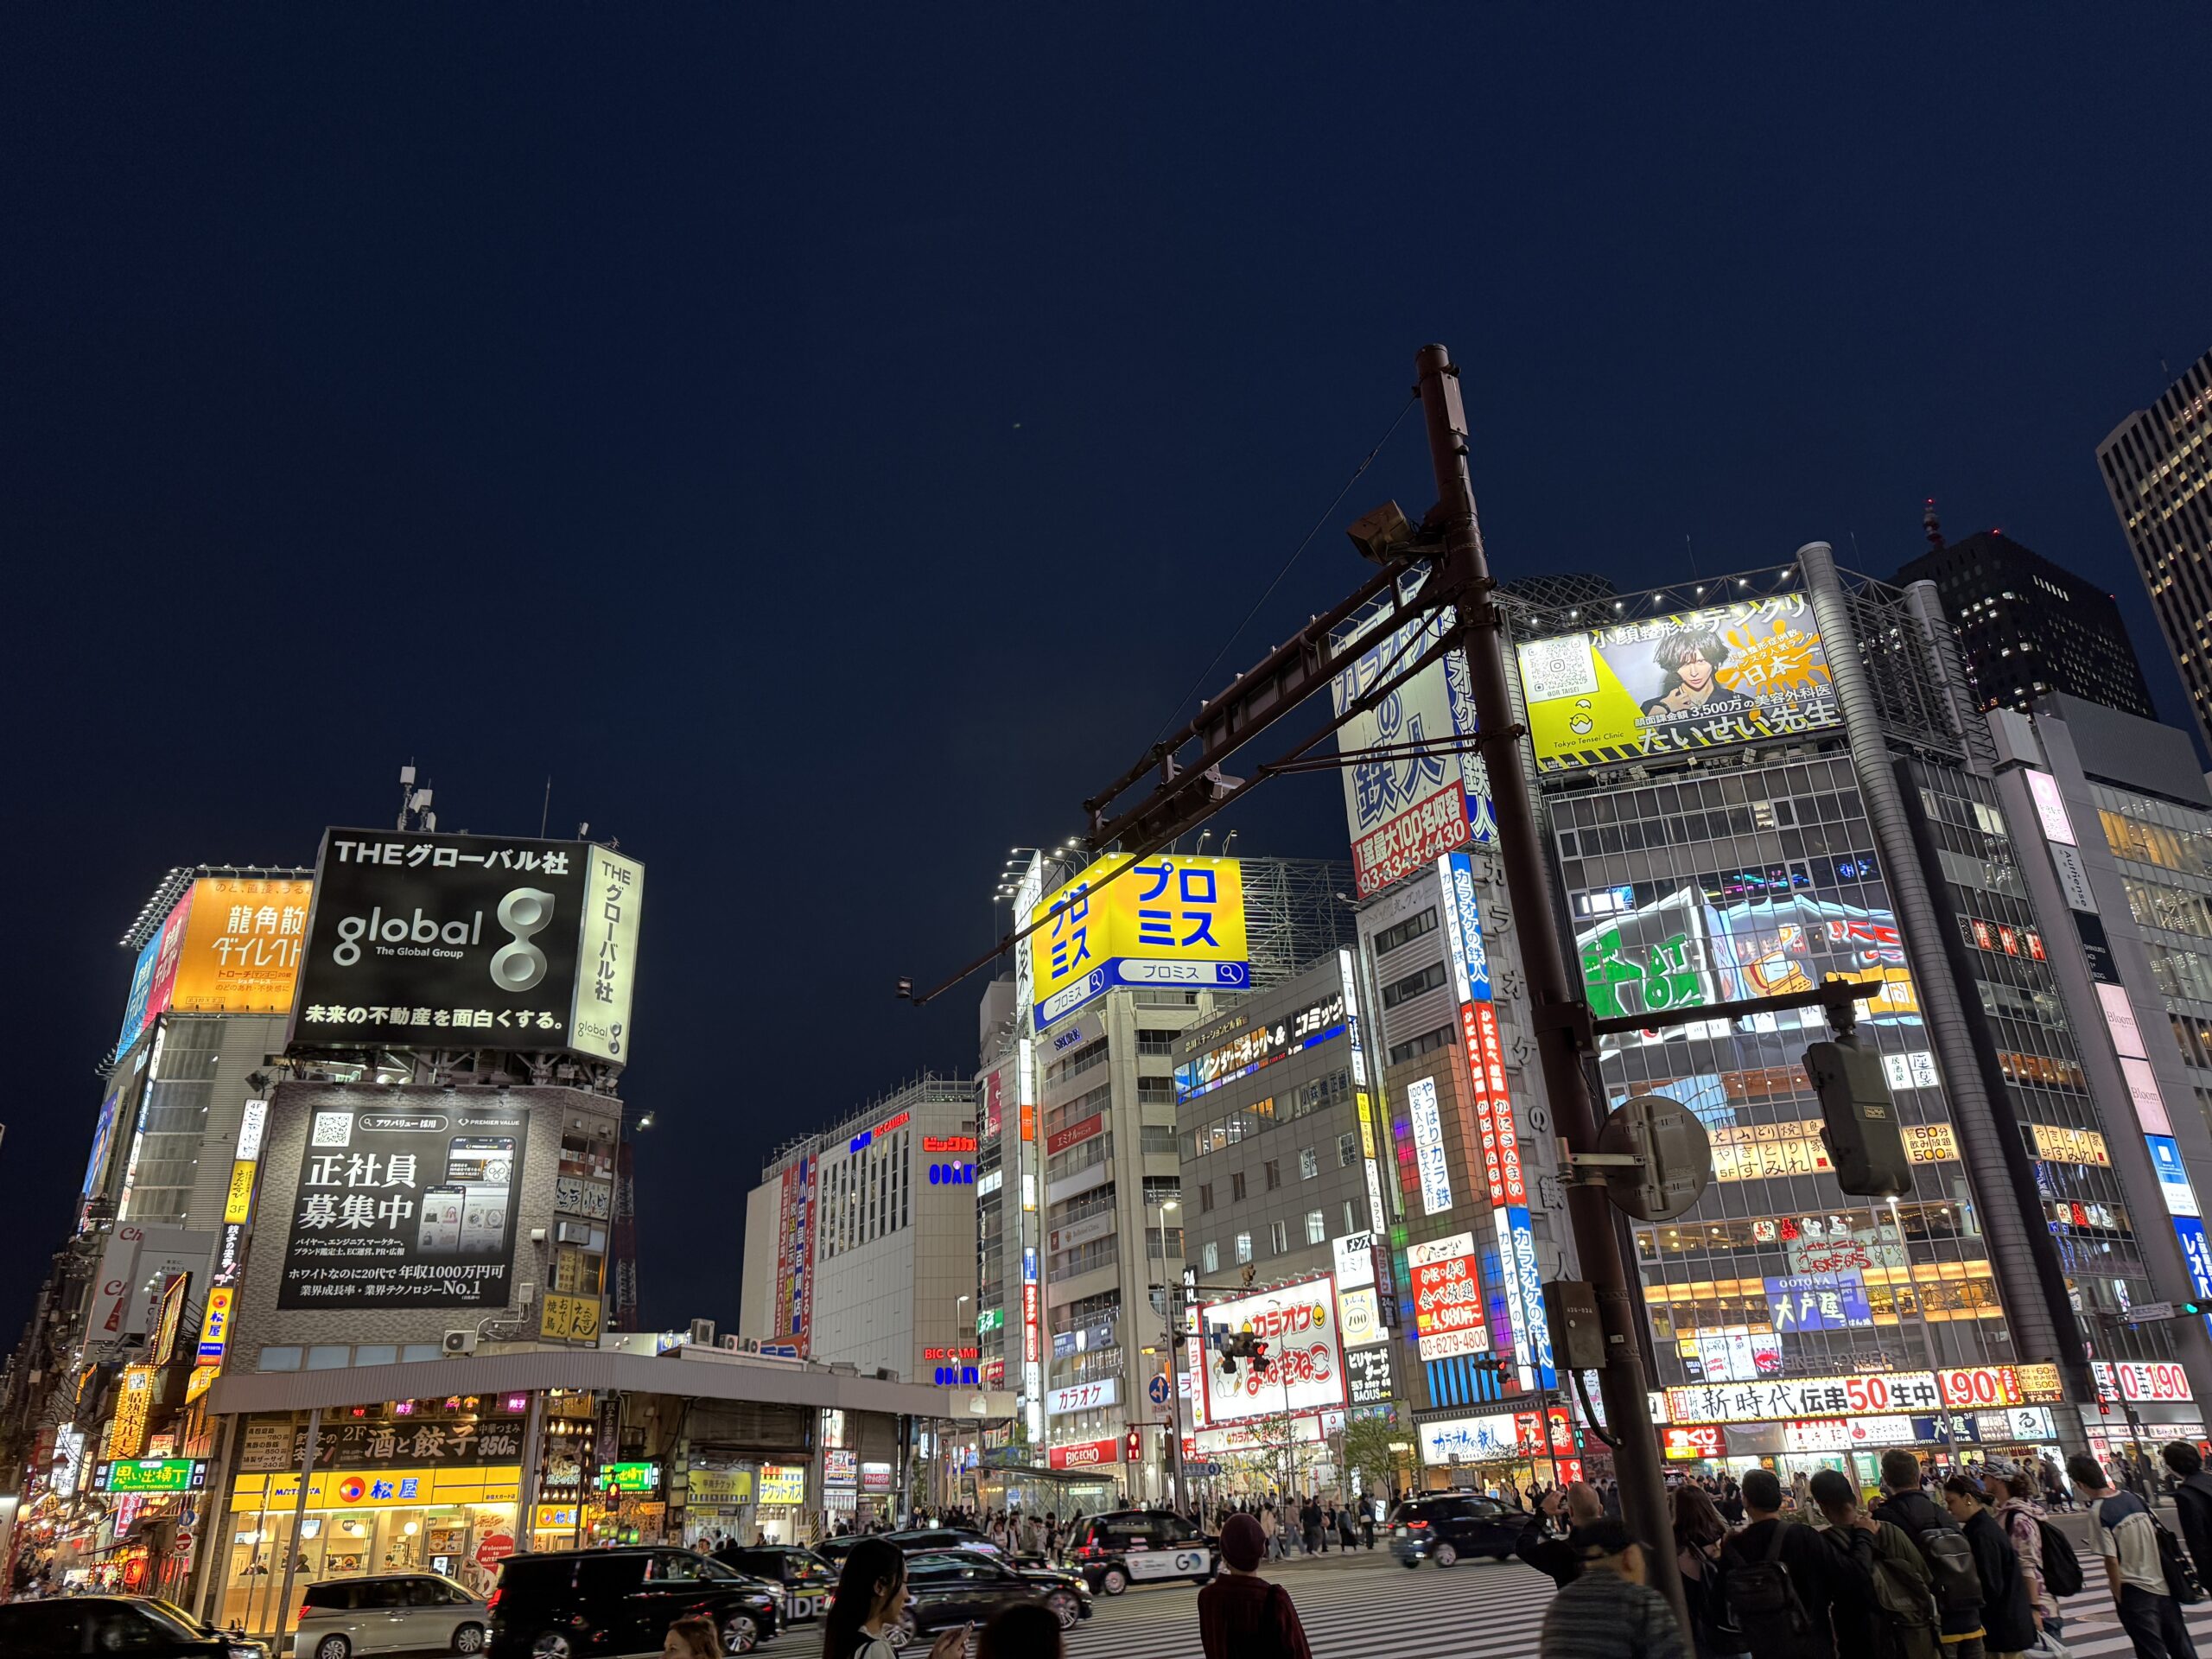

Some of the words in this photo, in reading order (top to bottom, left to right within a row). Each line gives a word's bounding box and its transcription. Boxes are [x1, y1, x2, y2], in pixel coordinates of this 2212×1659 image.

[1591, 594, 1807, 650] 小顔整形ならテンクリ
[1744, 647, 1820, 687] 日本一
[1554, 738, 1575, 748] Tokyo
[1578, 735, 1602, 745] Tensei
[1603, 731, 1624, 741] Clinic
[1638, 701, 1841, 754] たいせい先生
[1353, 714, 1446, 832] 鉄人
[1356, 788, 1460, 873] 1室最大100名収容
[335, 841, 569, 874] THEグローバル社
[1134, 861, 1217, 903] プロ
[2063, 850, 2088, 907] Authense
[227, 905, 306, 936] 龍角散
[596, 861, 631, 1003] THEグローバル社
[1138, 910, 1221, 947] ミス
[1441, 872, 1467, 983] カラオケの鉄人
[1454, 869, 1490, 984] カラオケの鉄人
[333, 906, 483, 966] global
[212, 938, 302, 967] ダイレクト
[376, 946, 395, 956] The
[397, 947, 430, 957] Global
[432, 949, 463, 960] Group
[1052, 925, 1091, 980] ミス
[218, 970, 251, 979] トローチ
[1143, 964, 1199, 979] プロミス
[1054, 987, 1082, 1013] プロミス
[305, 1004, 562, 1030] 未来の不動産を面白くする。
[578, 1020, 608, 1038] global
[1295, 995, 1344, 1038] コミック
[2107, 1009, 2134, 1026] Bloom
[2131, 1086, 2159, 1102] Bloom
[420, 1119, 436, 1128] 採用
[873, 1126, 883, 1138] BIC
[884, 1112, 910, 1132] CAMERA
[1916, 1126, 1948, 1139] 60分
[923, 1136, 976, 1153] ビックカ
[1058, 1131, 1077, 1147] エミナル
[1422, 1081, 1451, 1208] やっぱりカラ鉄
[1910, 1138, 1952, 1149] 飲み放題
[1719, 1167, 1735, 1179] 5F
[1738, 1156, 1810, 1179] すみれ
[2041, 1147, 2052, 1157] 5F
[2053, 1146, 2094, 1164] すみれ
[305, 1154, 417, 1189] 正社員
[929, 1164, 976, 1185] ODAK
[230, 1205, 245, 1214] 3F
[298, 1193, 415, 1230] 募集中
[793, 1180, 807, 1317] 小田急百貨店
[1348, 1234, 1370, 1253] メンズ
[289, 1268, 396, 1280] ホワイトなのに20代で
[398, 1264, 505, 1280] 年収1000万円可
[1184, 1270, 1196, 1286] 24
[1779, 1276, 1831, 1288] OOTOYA
[301, 1281, 481, 1297] 業界成長率・業界テクノロジーNo.1
[1419, 1279, 1477, 1311] 食べ放題
[1498, 1230, 1528, 1366] カラオケの鉄人
[1514, 1227, 1554, 1369] カラオケの鉄人
[557, 1299, 569, 1336] おでん
[1252, 1304, 1312, 1340] カラオケ
[1775, 1289, 1846, 1331] 大戸屋
[208, 1311, 224, 1336] 松屋
[925, 1348, 944, 1359] BIC
[1421, 1330, 1487, 1357] 03-6279-4800
[1349, 1348, 1388, 1369] ビリヤード
[1365, 1363, 1390, 1382] ダーツ
[2001, 1370, 2013, 1392] 2F
[2135, 1364, 2151, 1399] 生中
[2145, 1365, 2188, 1399] 190
[509, 1399, 526, 1410] 餃子
[1059, 1384, 1102, 1410] カラオケ
[1701, 1384, 1796, 1420] 新時代
[1800, 1386, 1849, 1413] 伝串
[1847, 1377, 1888, 1412] 50
[1890, 1382, 1937, 1410] 生中
[2028, 1393, 2054, 1402] すみれ
[343, 1427, 367, 1441] 2F
[365, 1425, 480, 1459] 酒と餃子
[479, 1424, 521, 1434] 中華つまみ
[1432, 1421, 1504, 1457] カラオケの鉄人
[113, 1466, 188, 1484] 思い出横丁
[370, 1478, 420, 1499] 松屋
[761, 1483, 787, 1500] チケット
